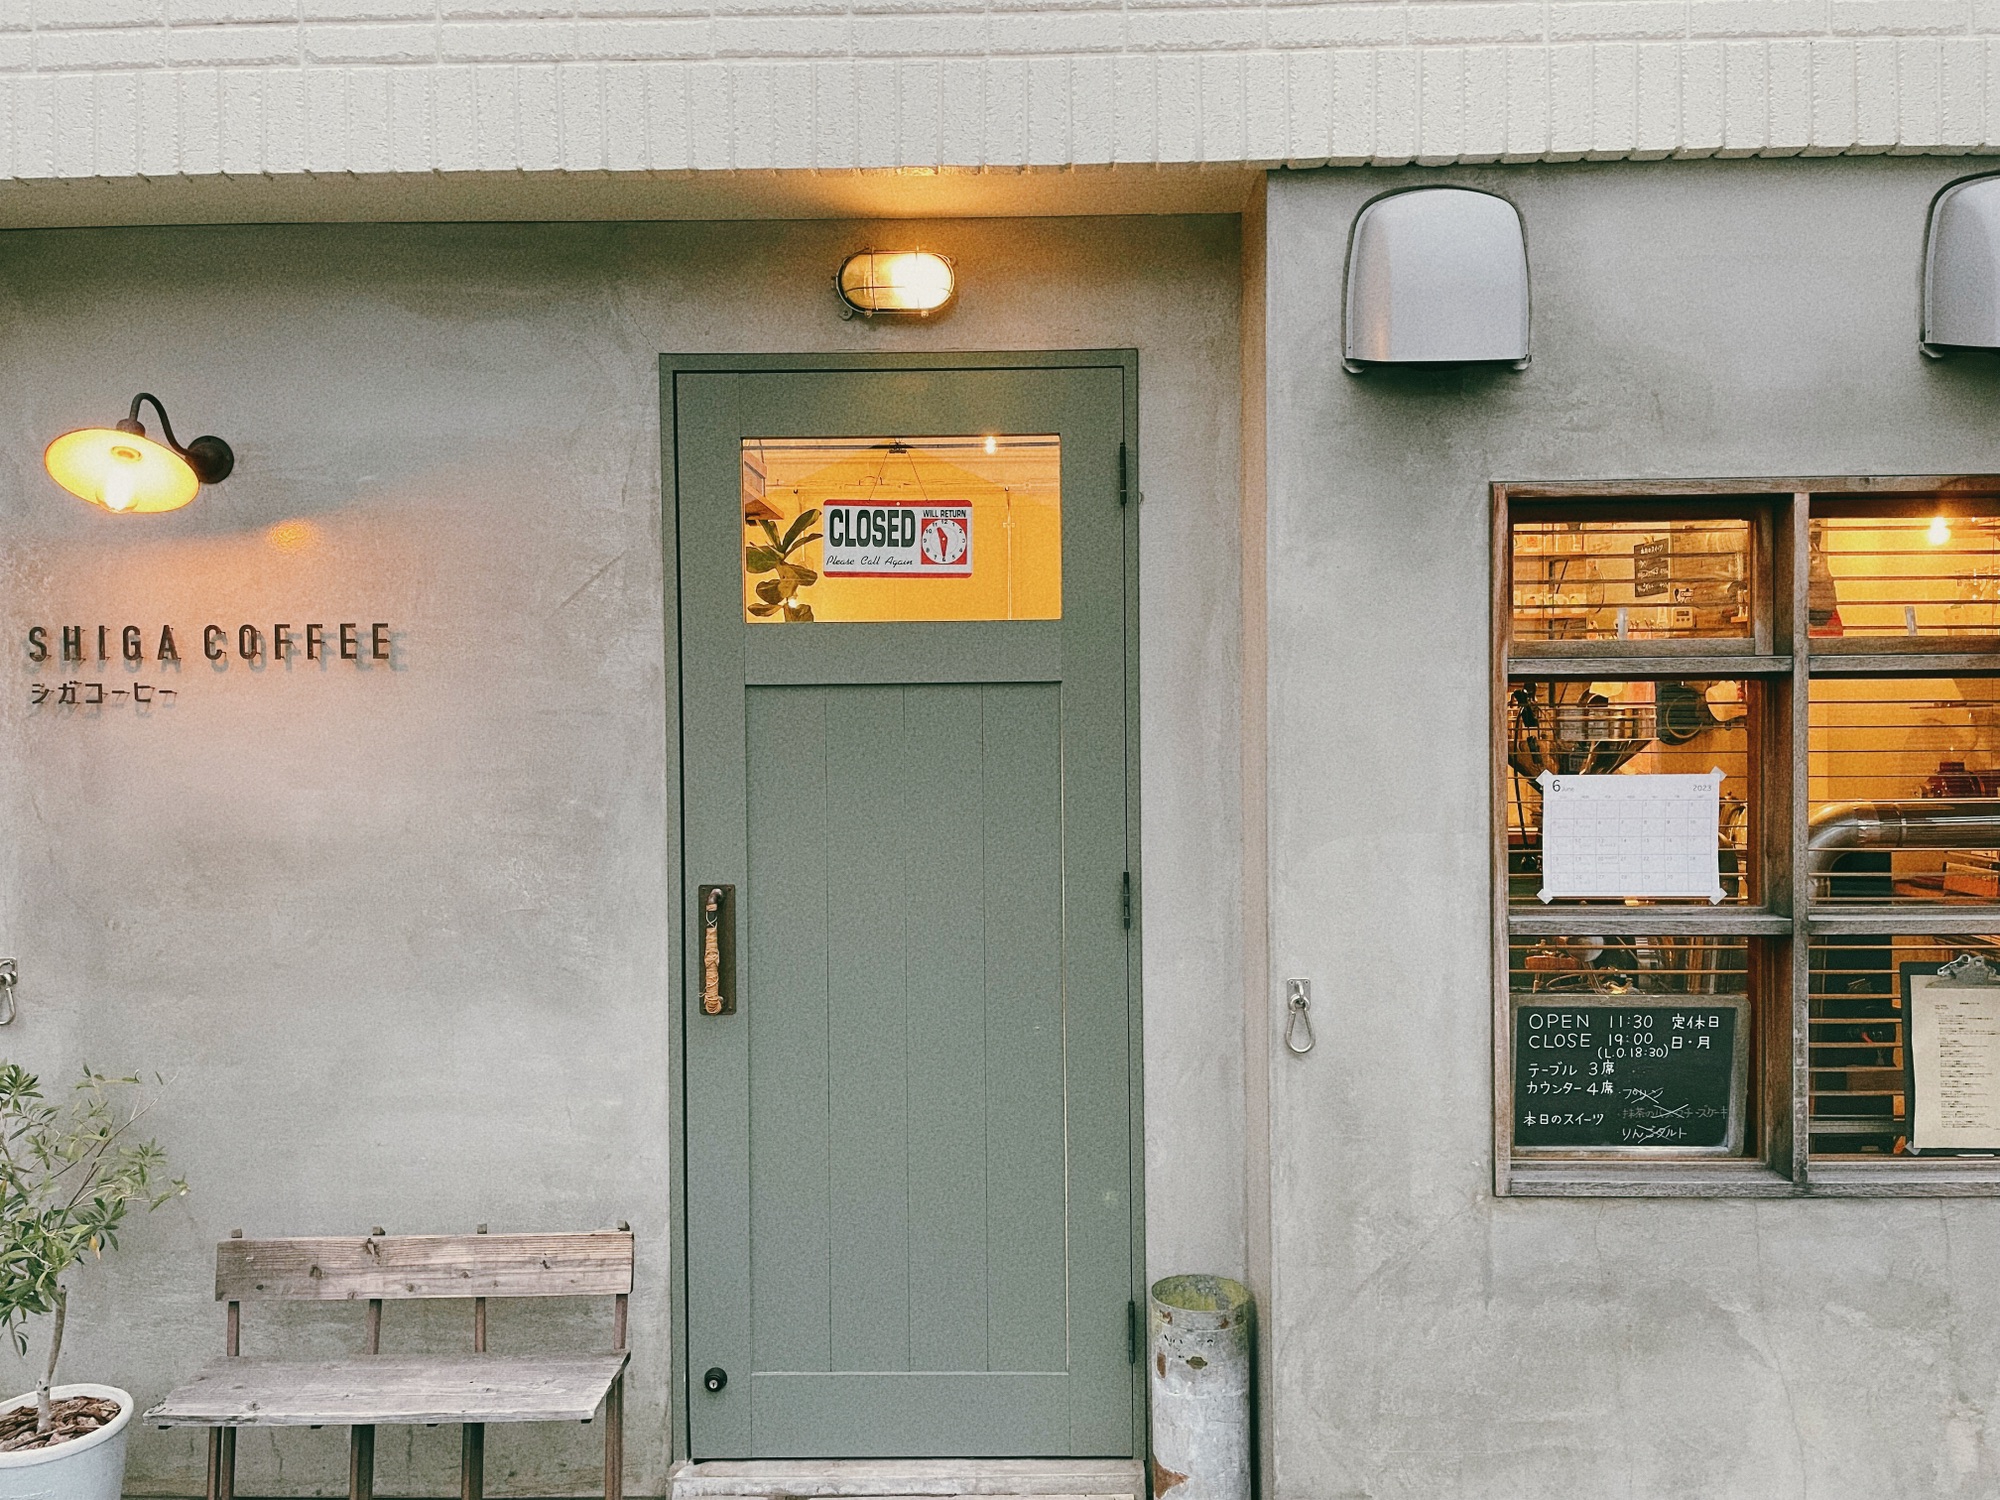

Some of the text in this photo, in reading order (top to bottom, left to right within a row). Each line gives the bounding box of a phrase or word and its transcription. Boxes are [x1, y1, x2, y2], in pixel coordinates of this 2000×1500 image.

[923, 509, 967, 518] WILL RETURN
[829, 508, 916, 548] CLOSED
[826, 555, 913, 568] Please Call Again
[28, 622, 391, 662] SHIGA COFFEE
[31, 680, 178, 704] シガコーヒー
[1552, 779, 1561, 792] 6
[1692, 784, 1712, 792] 2023
[1529, 1013, 1653, 1029] OPEN 11:30
[1671, 1013, 1719, 1030] 定休日
[1528, 1032, 1653, 1049] CLOSE 19:00
[1523, 1110, 1604, 1127] 本日のスイーツ
